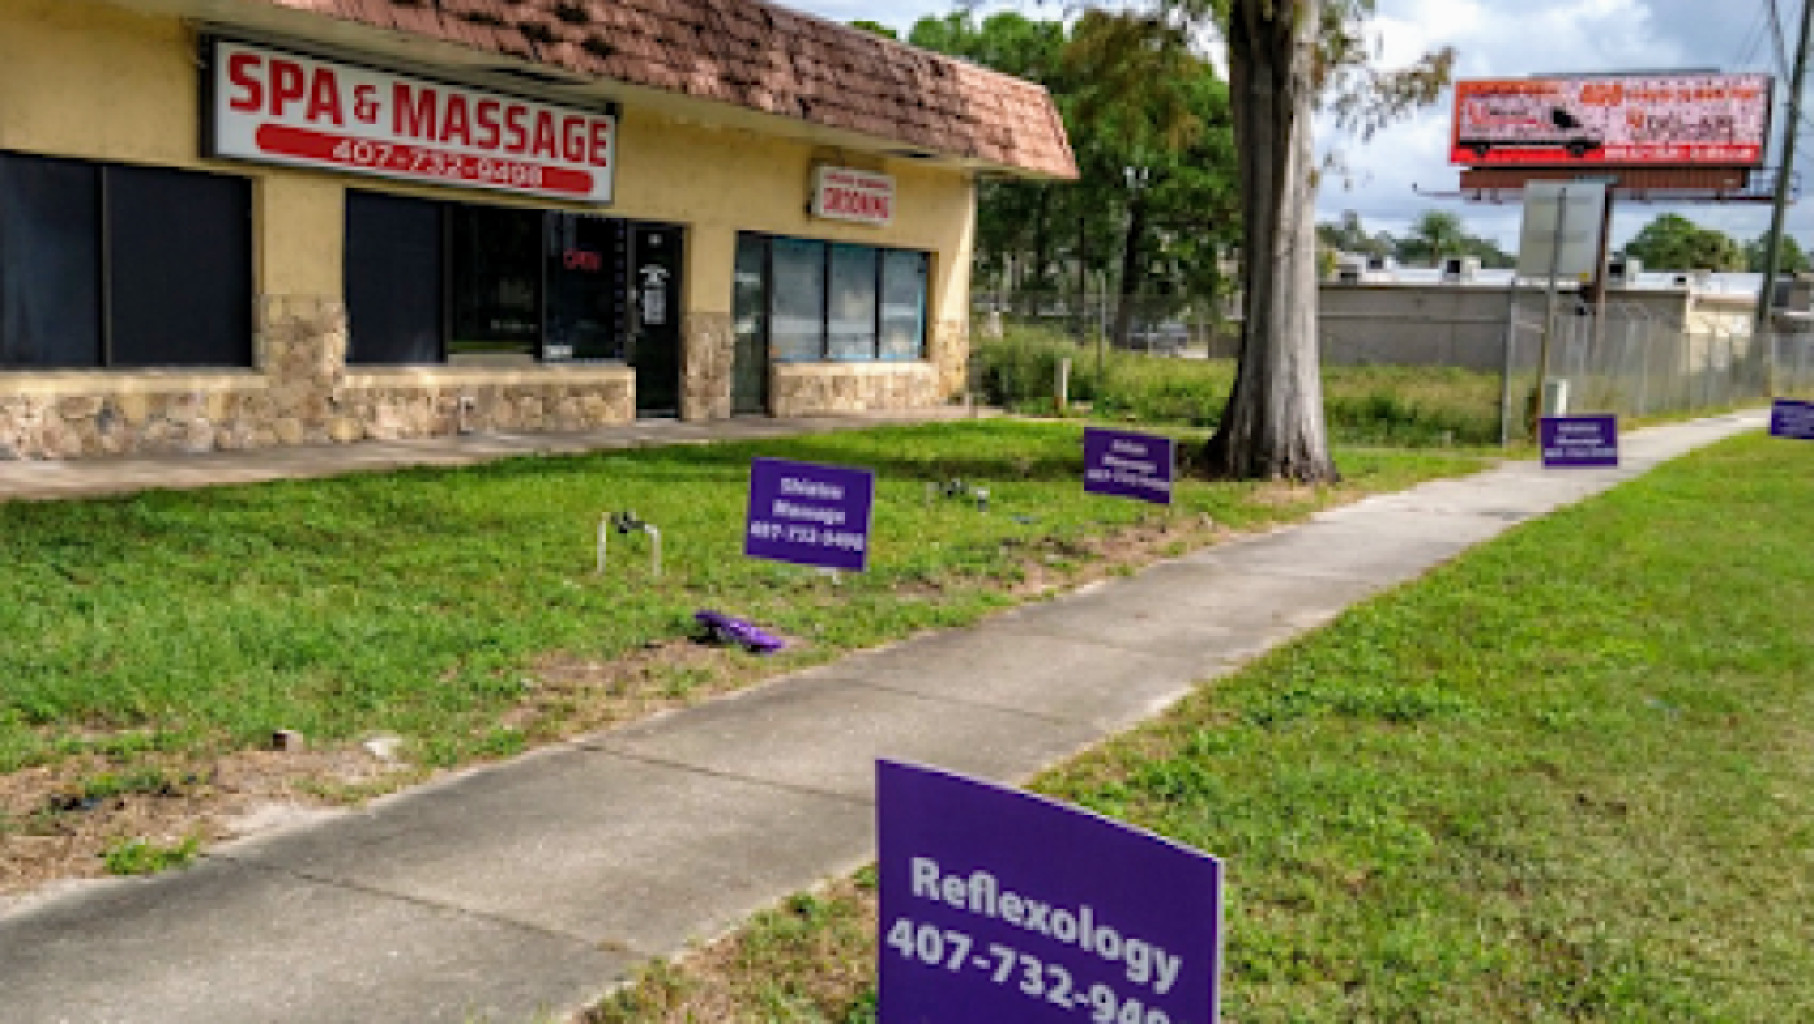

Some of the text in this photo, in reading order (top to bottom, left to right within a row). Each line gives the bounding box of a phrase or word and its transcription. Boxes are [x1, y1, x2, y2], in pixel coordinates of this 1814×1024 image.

[228, 52, 608, 167] SPA & MASSAGE
[771, 499, 846, 526] Massage
[909, 855, 1183, 995] Reflexology
